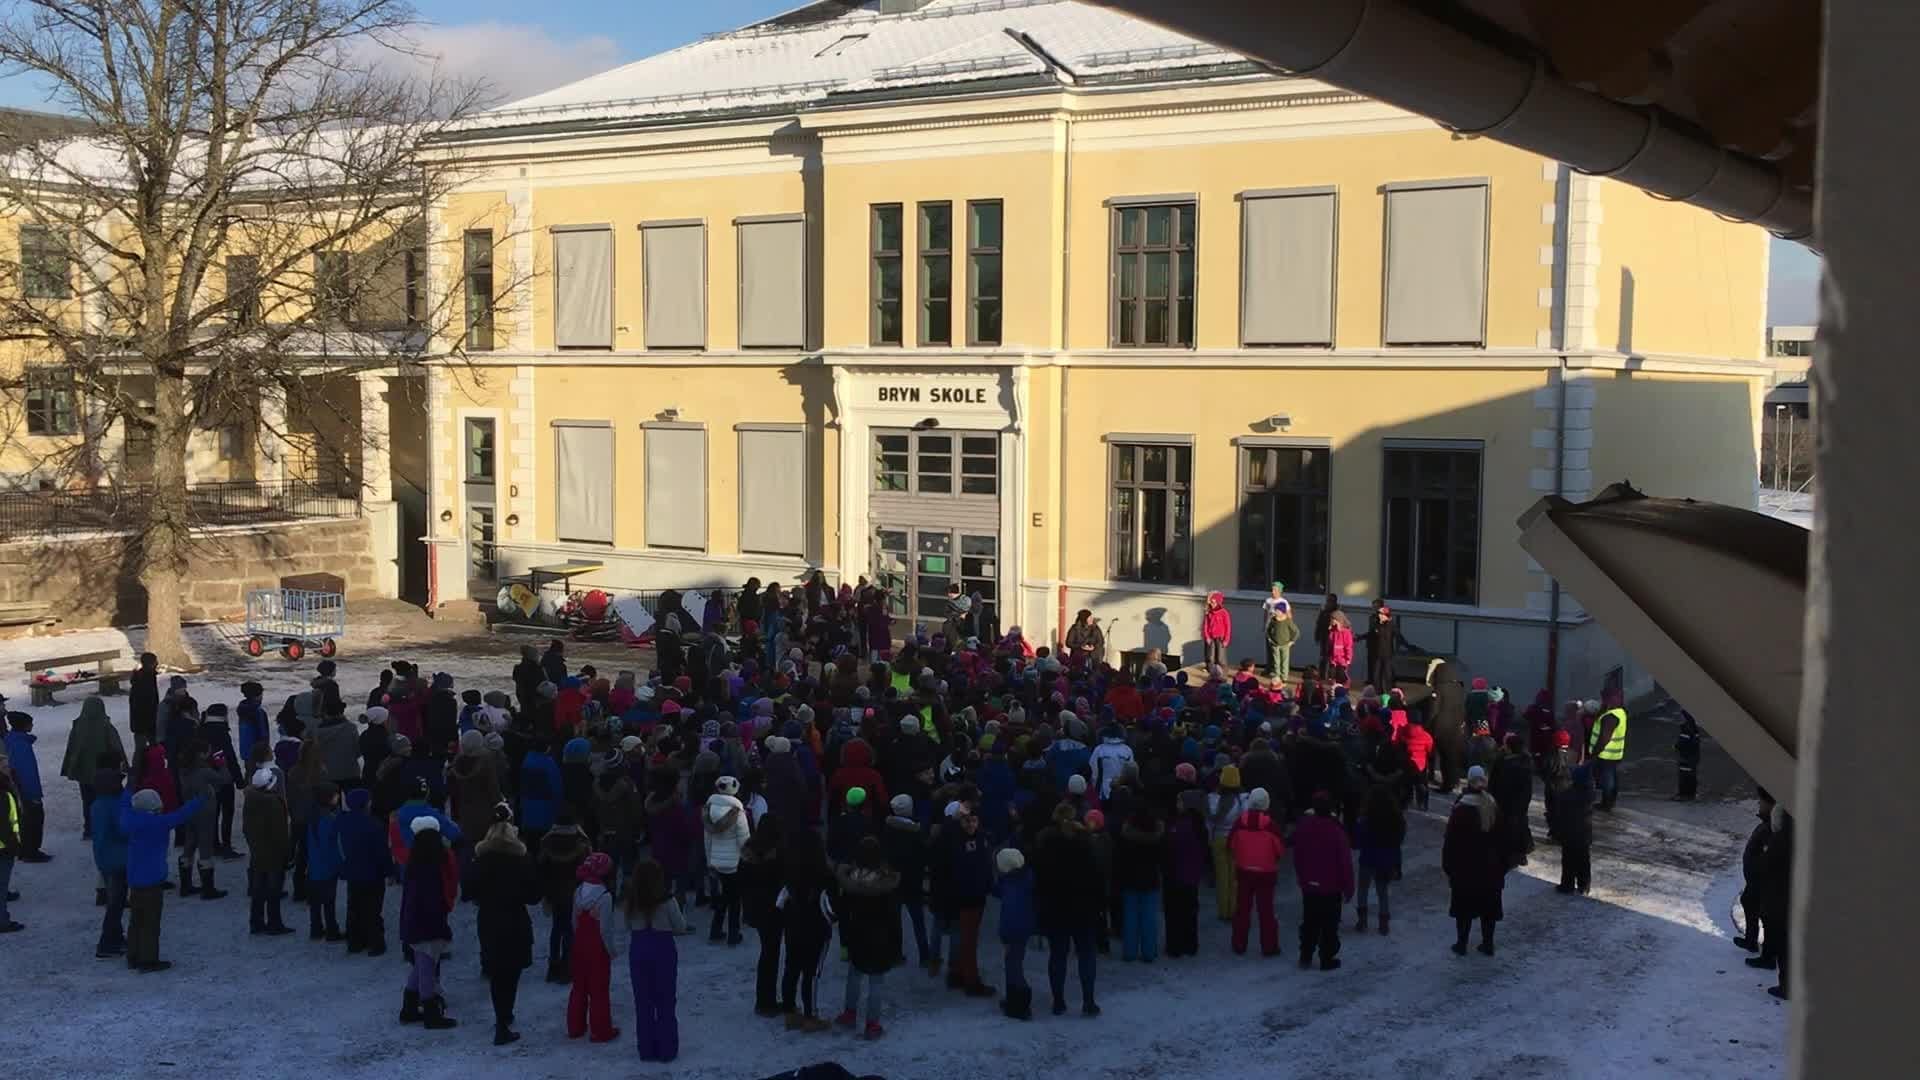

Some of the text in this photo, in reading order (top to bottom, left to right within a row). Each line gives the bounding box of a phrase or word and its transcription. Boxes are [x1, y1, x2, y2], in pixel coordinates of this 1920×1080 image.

[878, 387, 986, 404] BRYN SKOLE
[510, 485, 518, 498] D
[1032, 512, 1042, 528] E
